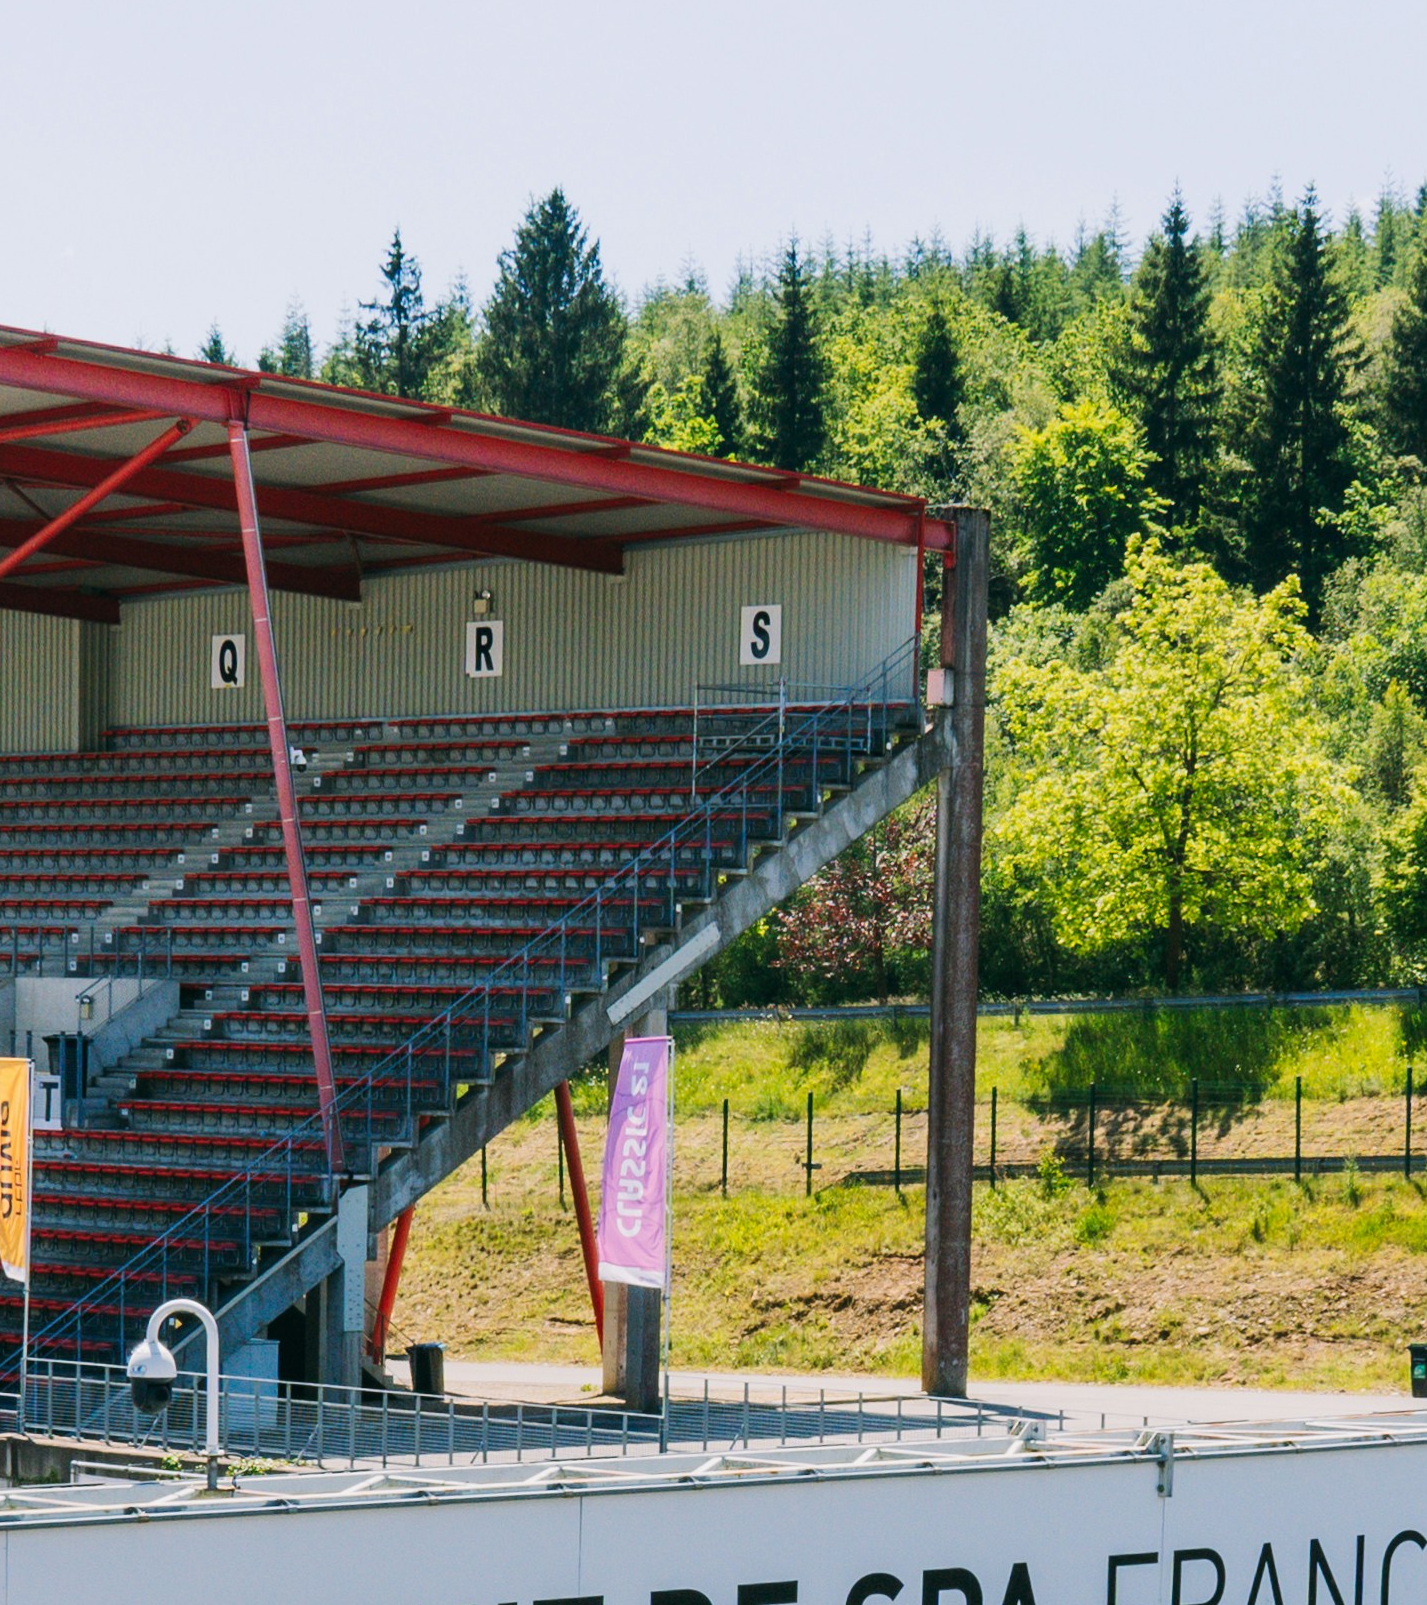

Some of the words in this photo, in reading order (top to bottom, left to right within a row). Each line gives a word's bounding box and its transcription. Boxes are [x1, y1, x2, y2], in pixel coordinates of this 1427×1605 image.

[474, 626, 494, 672] R
[750, 610, 771, 660] S
[218, 639, 238, 685] Q
[39, 1081, 59, 1122] T
